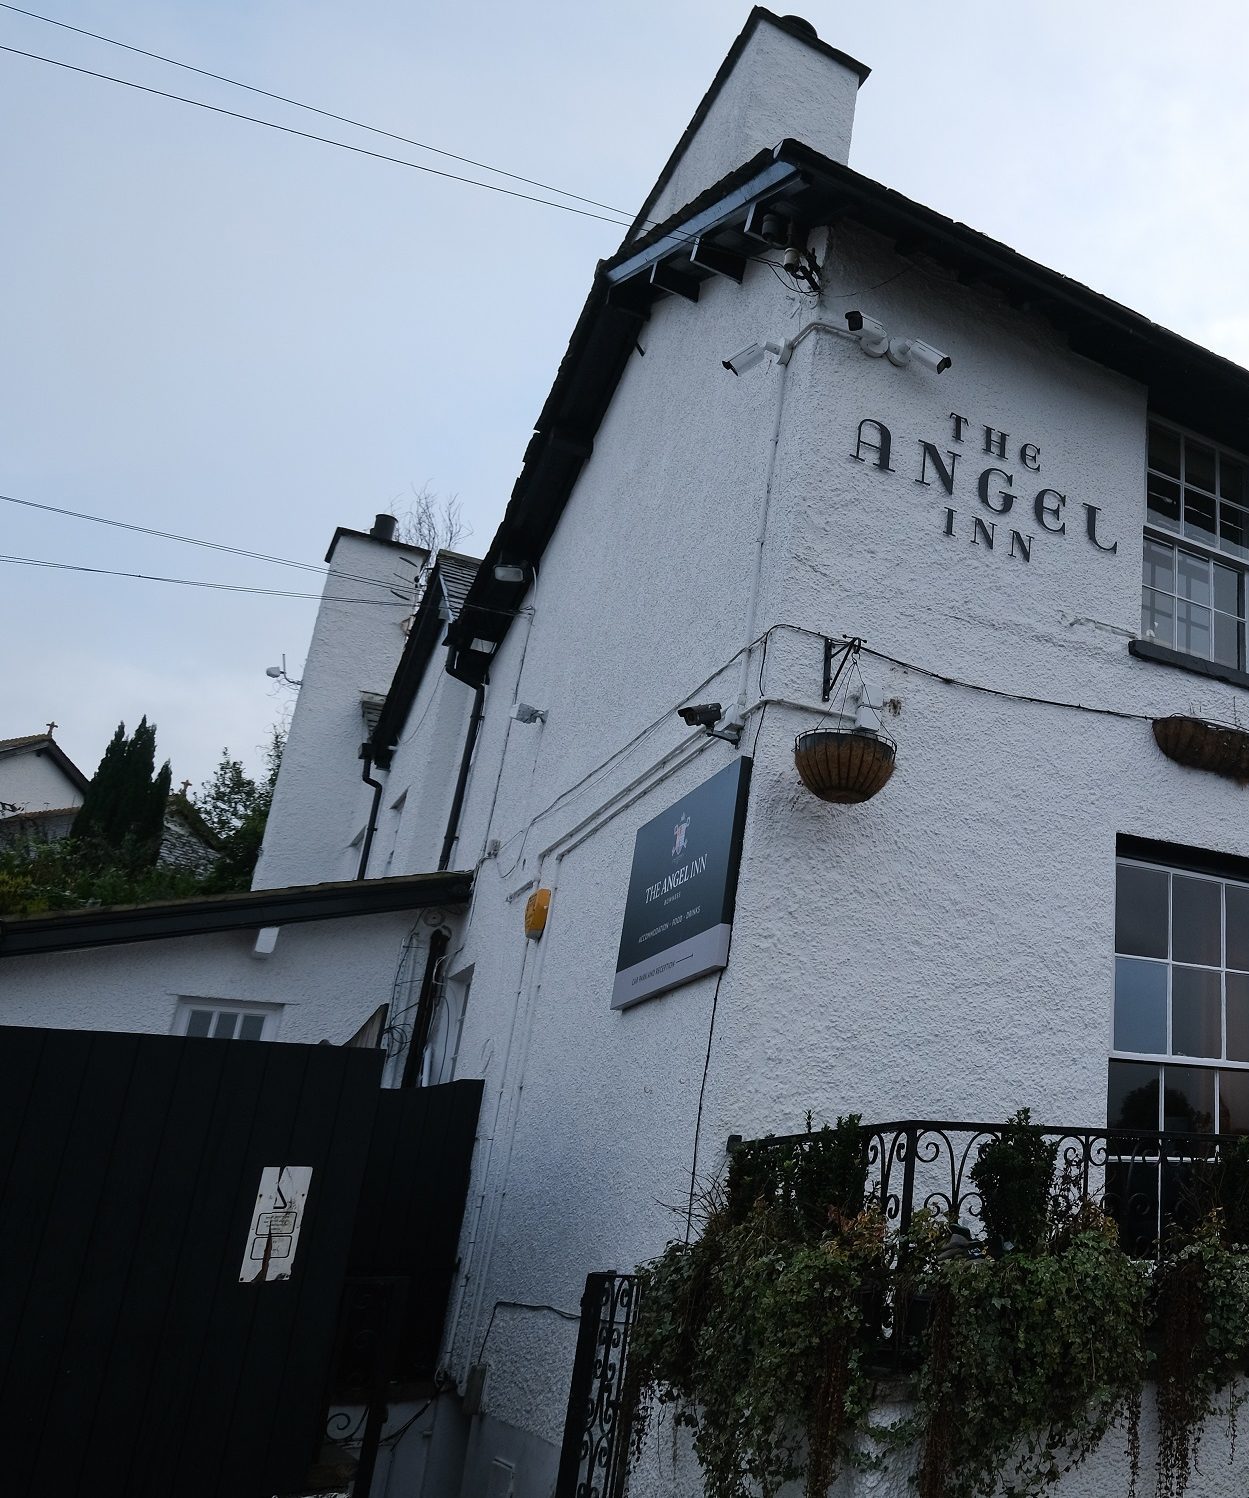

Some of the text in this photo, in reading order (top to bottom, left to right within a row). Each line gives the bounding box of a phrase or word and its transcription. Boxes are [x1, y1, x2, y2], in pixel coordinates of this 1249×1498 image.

[949, 411, 1041, 473] THE
[849, 418, 1118, 555] ANGEL
[942, 506, 1035, 564] INN
[645, 853, 708, 904] THE ANGEL INN
